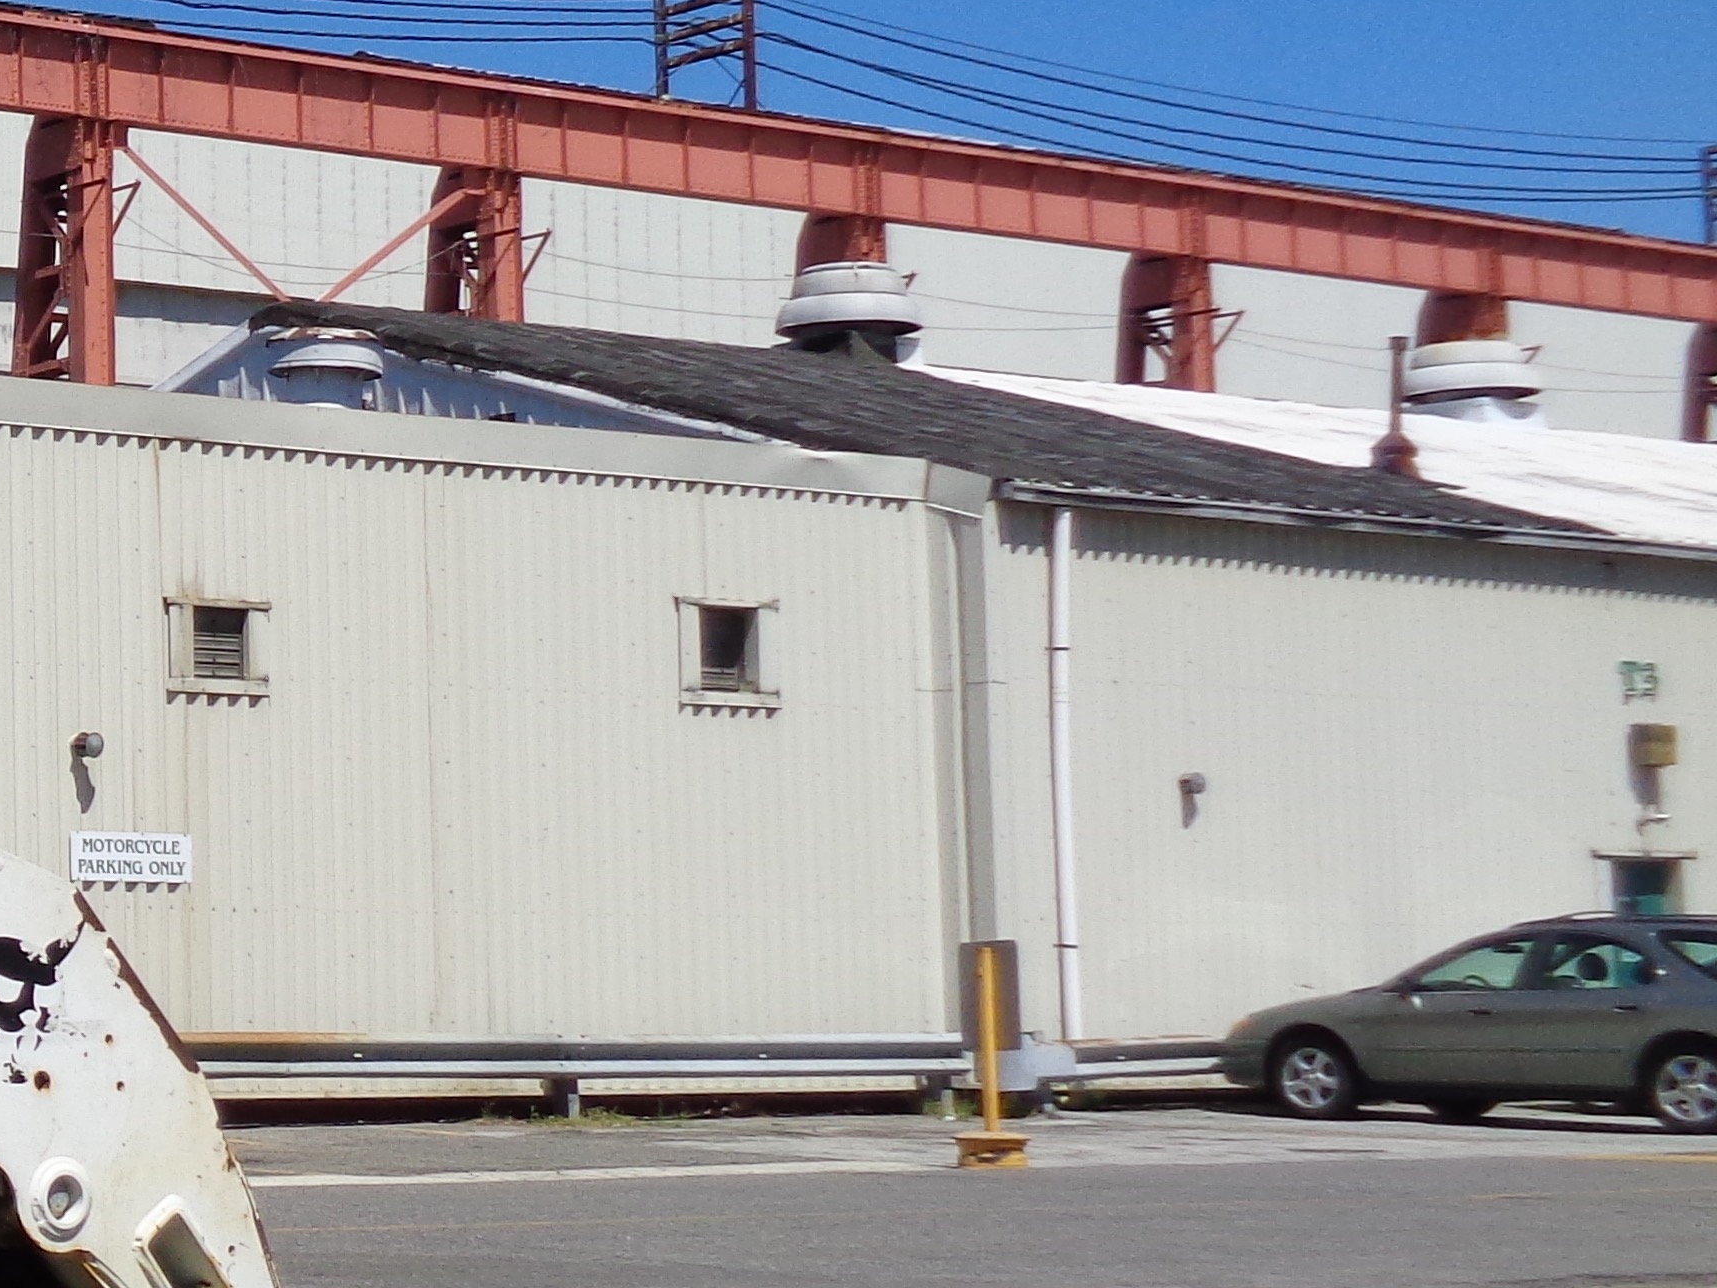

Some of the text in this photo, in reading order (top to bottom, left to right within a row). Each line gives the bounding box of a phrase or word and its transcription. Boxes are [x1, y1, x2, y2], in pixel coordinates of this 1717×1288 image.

[82, 838, 180, 855] MOTORCYCLE
[78, 859, 186, 876] PARKING ONLY
